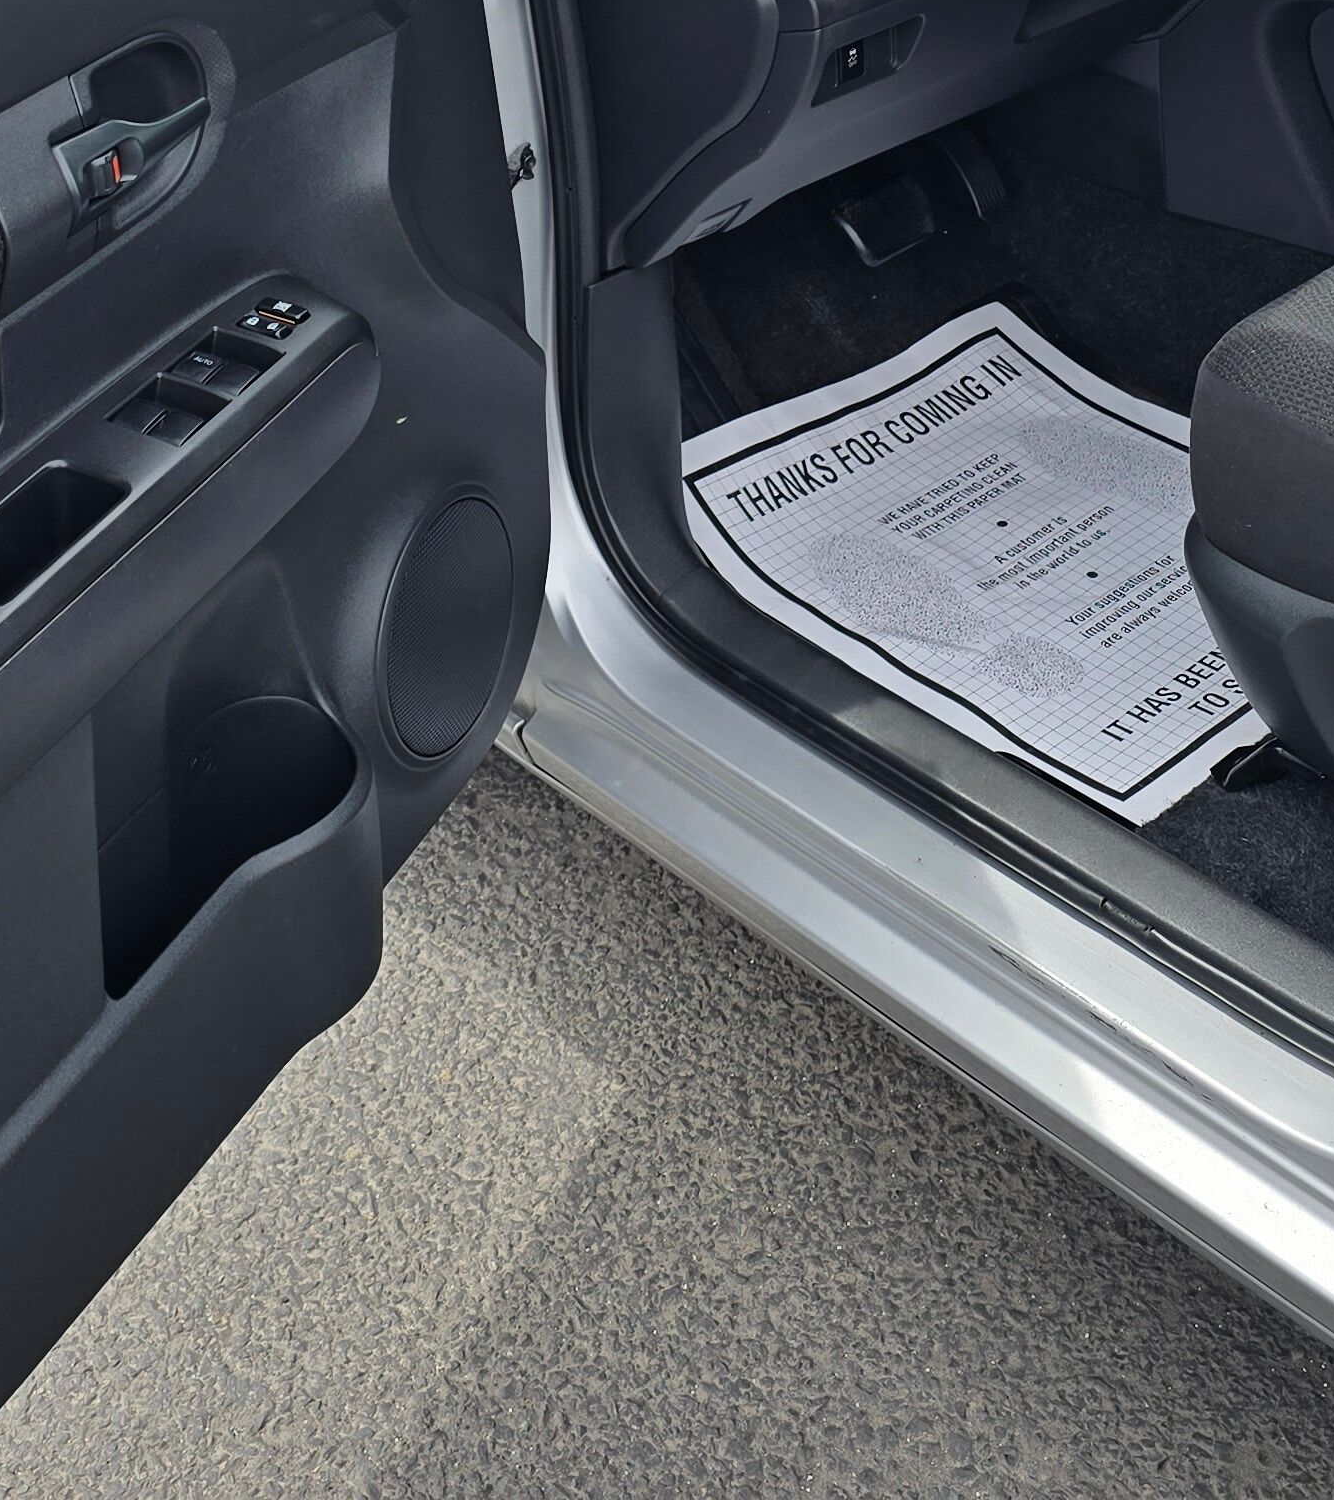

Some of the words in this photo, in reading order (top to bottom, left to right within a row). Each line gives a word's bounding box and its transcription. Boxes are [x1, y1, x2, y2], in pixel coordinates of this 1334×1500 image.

[726, 452, 839, 522] THANKS
[830, 429, 895, 474] FOR
[884, 375, 993, 444] COMING
[980, 354, 1023, 387] IN
[878, 510, 899, 525] WE
[896, 495, 929, 516] HAVE
[926, 478, 960, 500] TRIED
[957, 468, 976, 481] TO
[973, 453, 1000, 473] KEEP
[892, 514, 927, 534] YOUR
[923, 482, 984, 518] CARPETING
[981, 461, 1018, 485] CLEAN
[912, 522, 946, 541] WITH
[941, 506, 970, 526] THIS
[966, 487, 1005, 510] PAPER
[1001, 472, 1027, 490] MAT
[977, 578, 1000, 591] the
[998, 561, 1028, 580] most
[1024, 527, 1081, 566] important
[1076, 505, 1116, 532] person
[993, 555, 1008, 565] A
[1005, 523, 1055, 558] customer
[1026, 567, 1049, 581] the
[1047, 546, 1080, 570] world
[1075, 538, 1093, 549] to
[1065, 606, 1097, 626] Your
[1094, 565, 1160, 609] suggestions
[1156, 554, 1177, 570] for
[1078, 598, 1141, 640] improving
[1136, 585, 1158, 603] our
[1100, 631, 1124, 649] are
[1120, 605, 1162, 634] always
[1101, 719, 1135, 742] IT
[1126, 686, 1183, 724] HAS
[1187, 692, 1230, 716] TO
